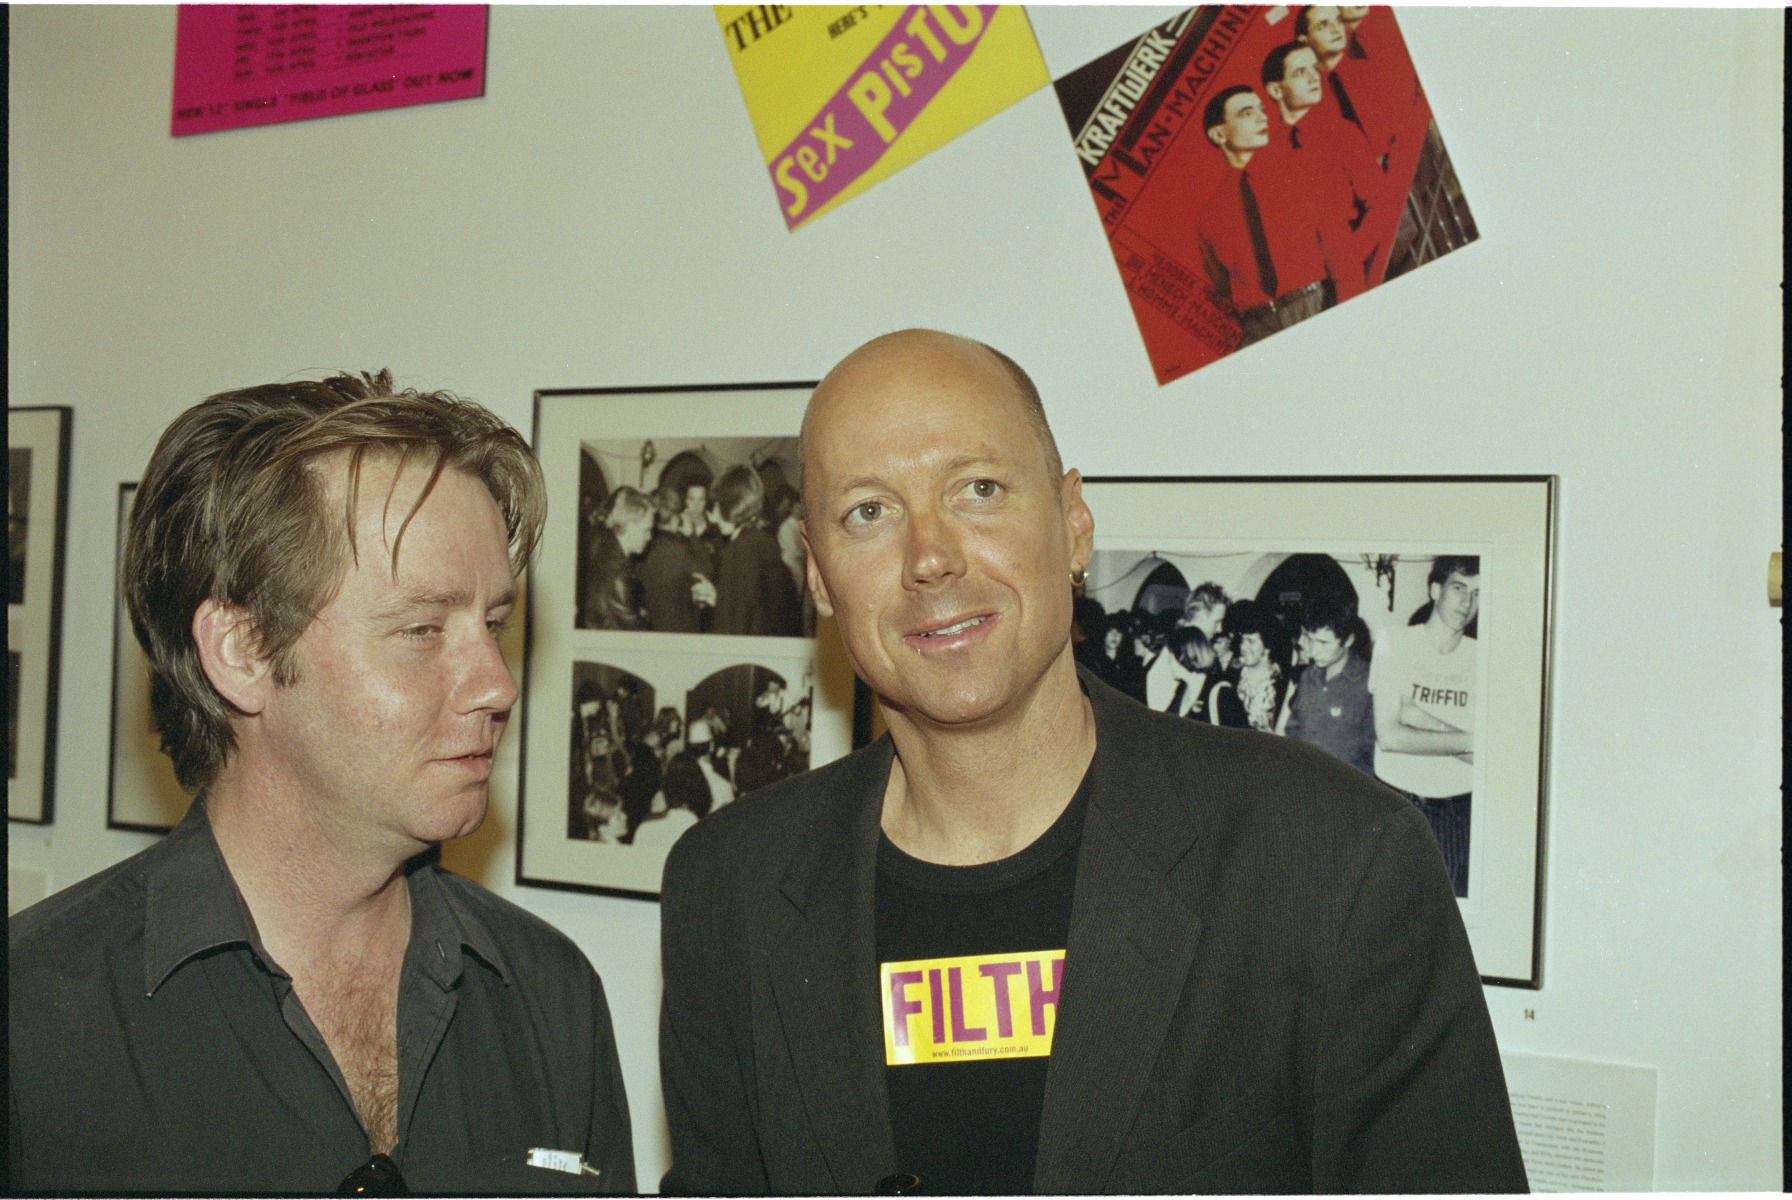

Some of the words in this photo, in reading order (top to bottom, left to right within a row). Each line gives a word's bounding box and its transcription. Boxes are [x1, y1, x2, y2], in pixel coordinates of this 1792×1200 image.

[724, 5, 793, 51] THE
[1076, 29, 1177, 167] KRAFTWERK
[1412, 683, 1468, 707] TRIFFID
[890, 958, 1065, 1047] FILTH
[1524, 1009, 1536, 1020] 14
[931, 1045, 1029, 1058] www.filthandfury.com.au
